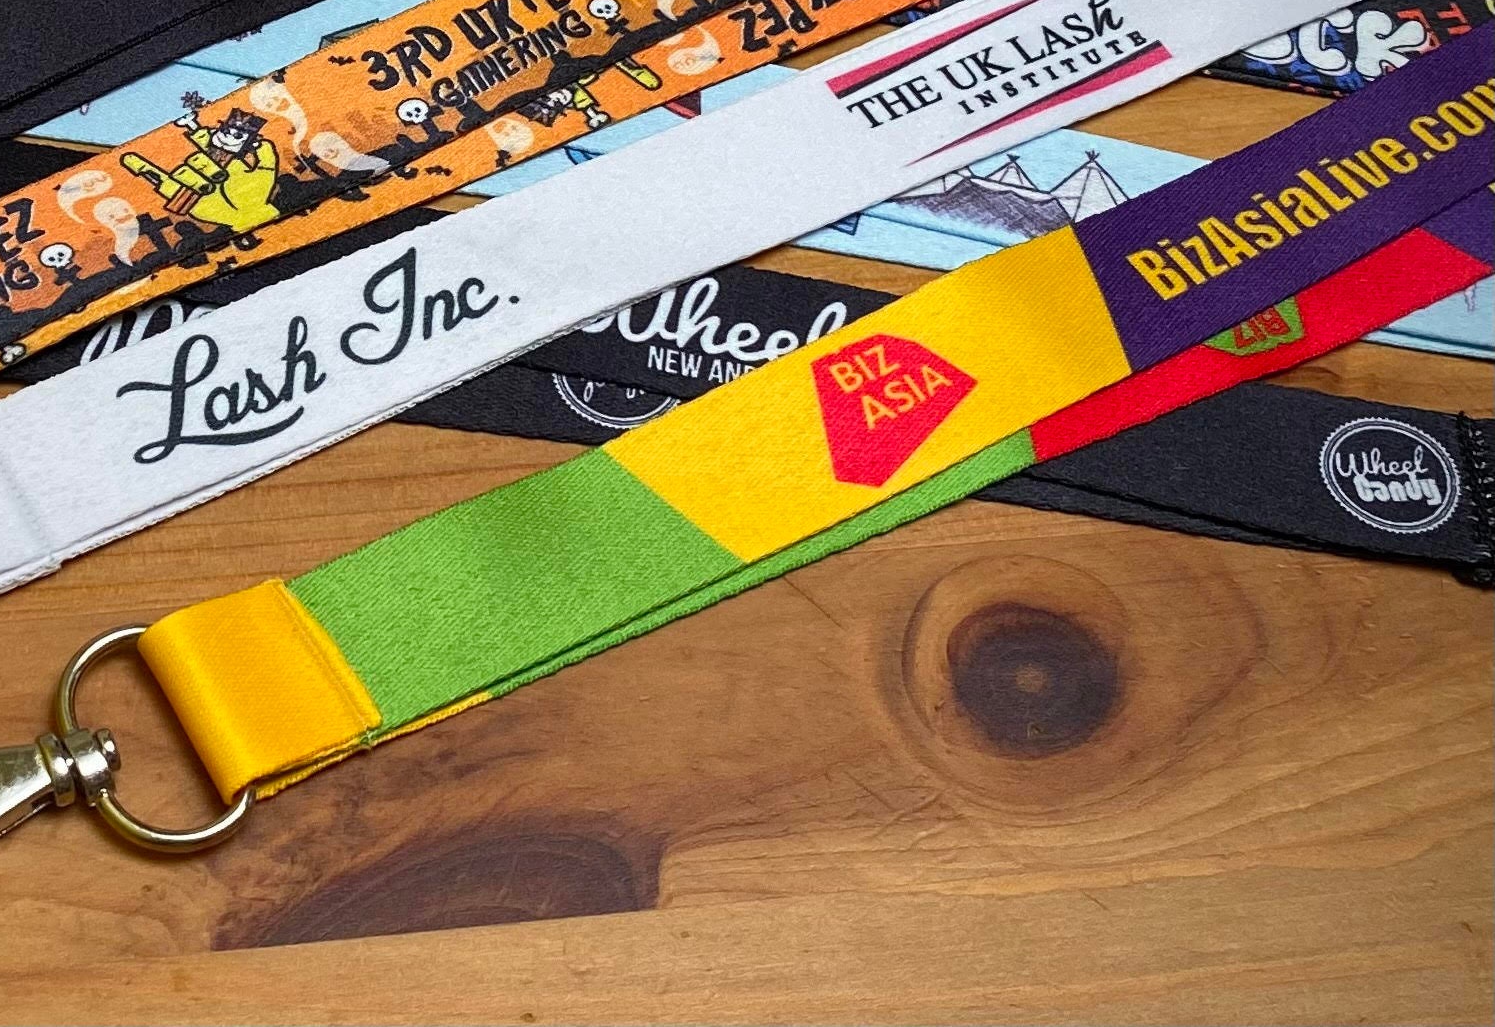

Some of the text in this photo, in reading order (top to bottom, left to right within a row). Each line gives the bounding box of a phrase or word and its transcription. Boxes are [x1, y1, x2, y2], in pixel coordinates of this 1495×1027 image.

[360, 26, 454, 92] 3RD
[430, 10, 593, 108] GATHERING
[845, 74, 944, 130] THE
[936, 45, 1015, 92] UK
[957, 29, 1149, 116] INSTITUTE
[116, 316, 327, 465] Lash
[340, 247, 522, 366] Inc.
[647, 345, 703, 380] NEW
[828, 343, 905, 396] BIZ
[860, 366, 955, 431] ASIA
[1335, 444, 1430, 478] Wheel
